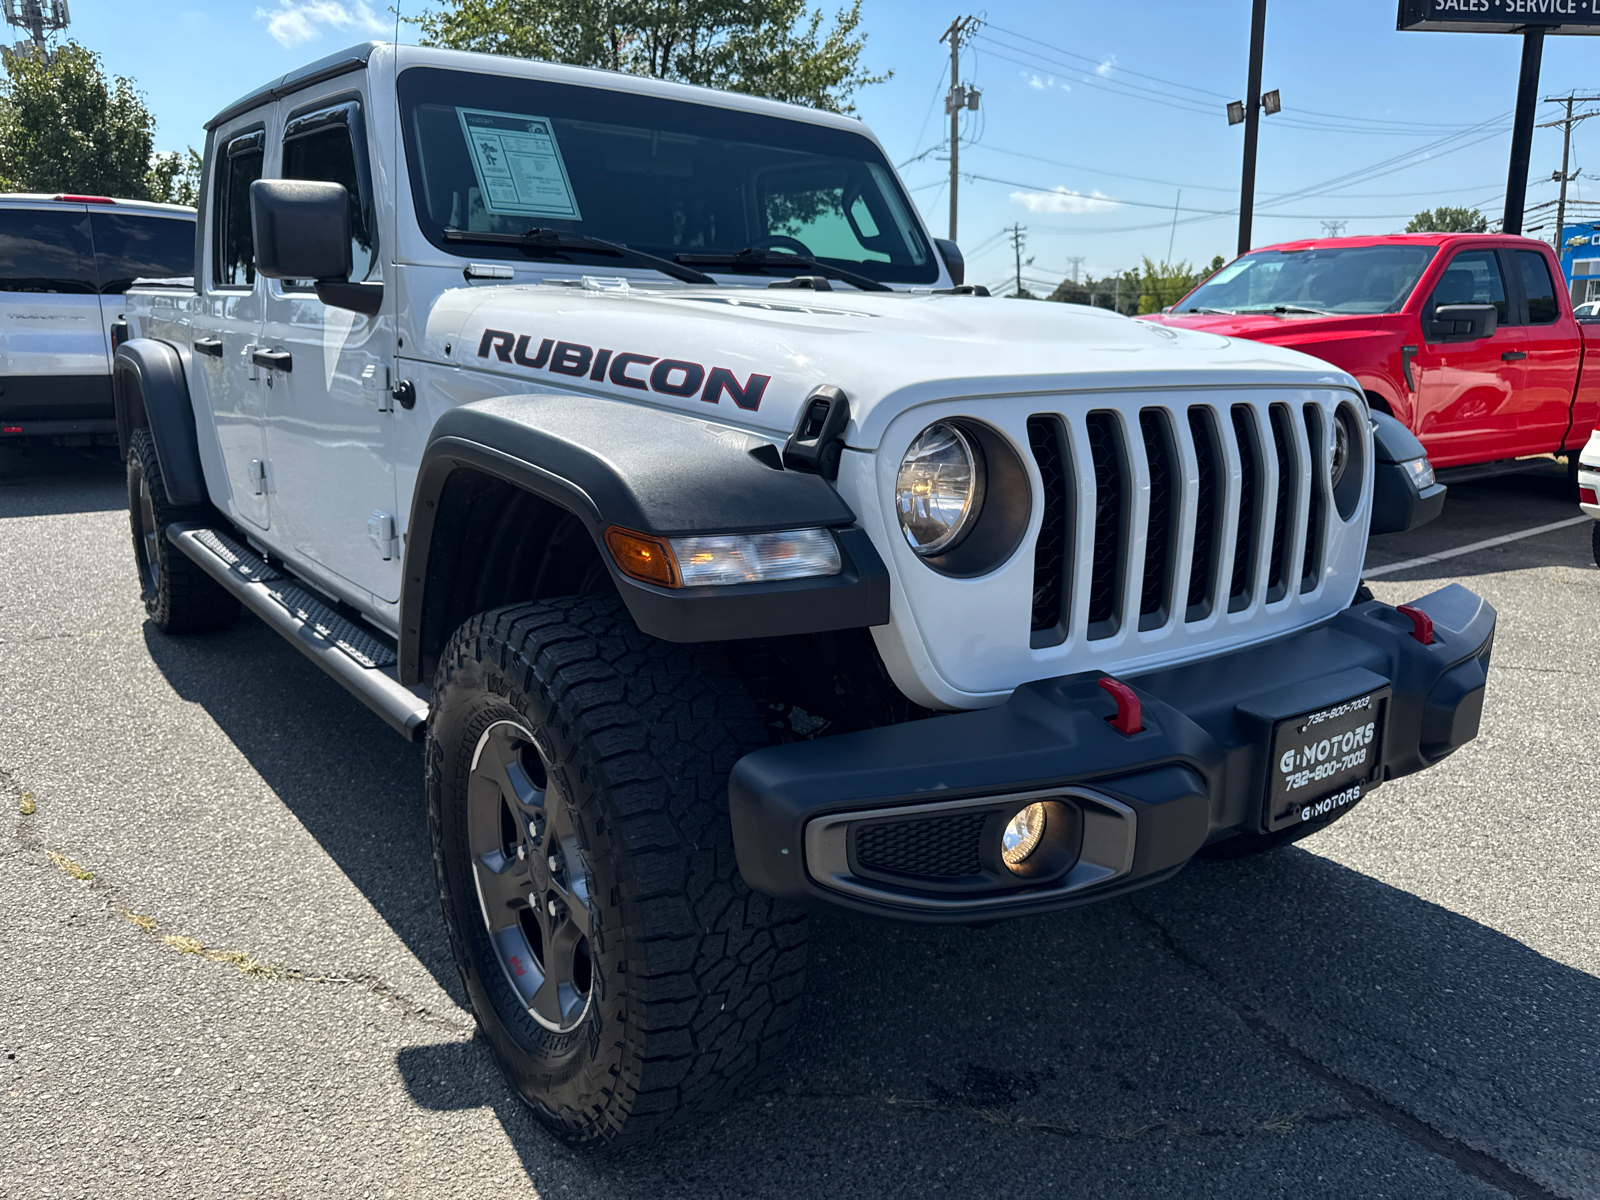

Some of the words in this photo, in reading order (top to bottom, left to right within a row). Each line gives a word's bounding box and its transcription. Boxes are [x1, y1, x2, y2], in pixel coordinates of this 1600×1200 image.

[1435, 0, 1489, 12] SALES
[1506, 0, 1577, 13] SERVICE
[477, 328, 772, 412] RUBICON
[1306, 695, 1371, 726] 732-800-7003
[1285, 747, 1367, 792] 732-800-7003
